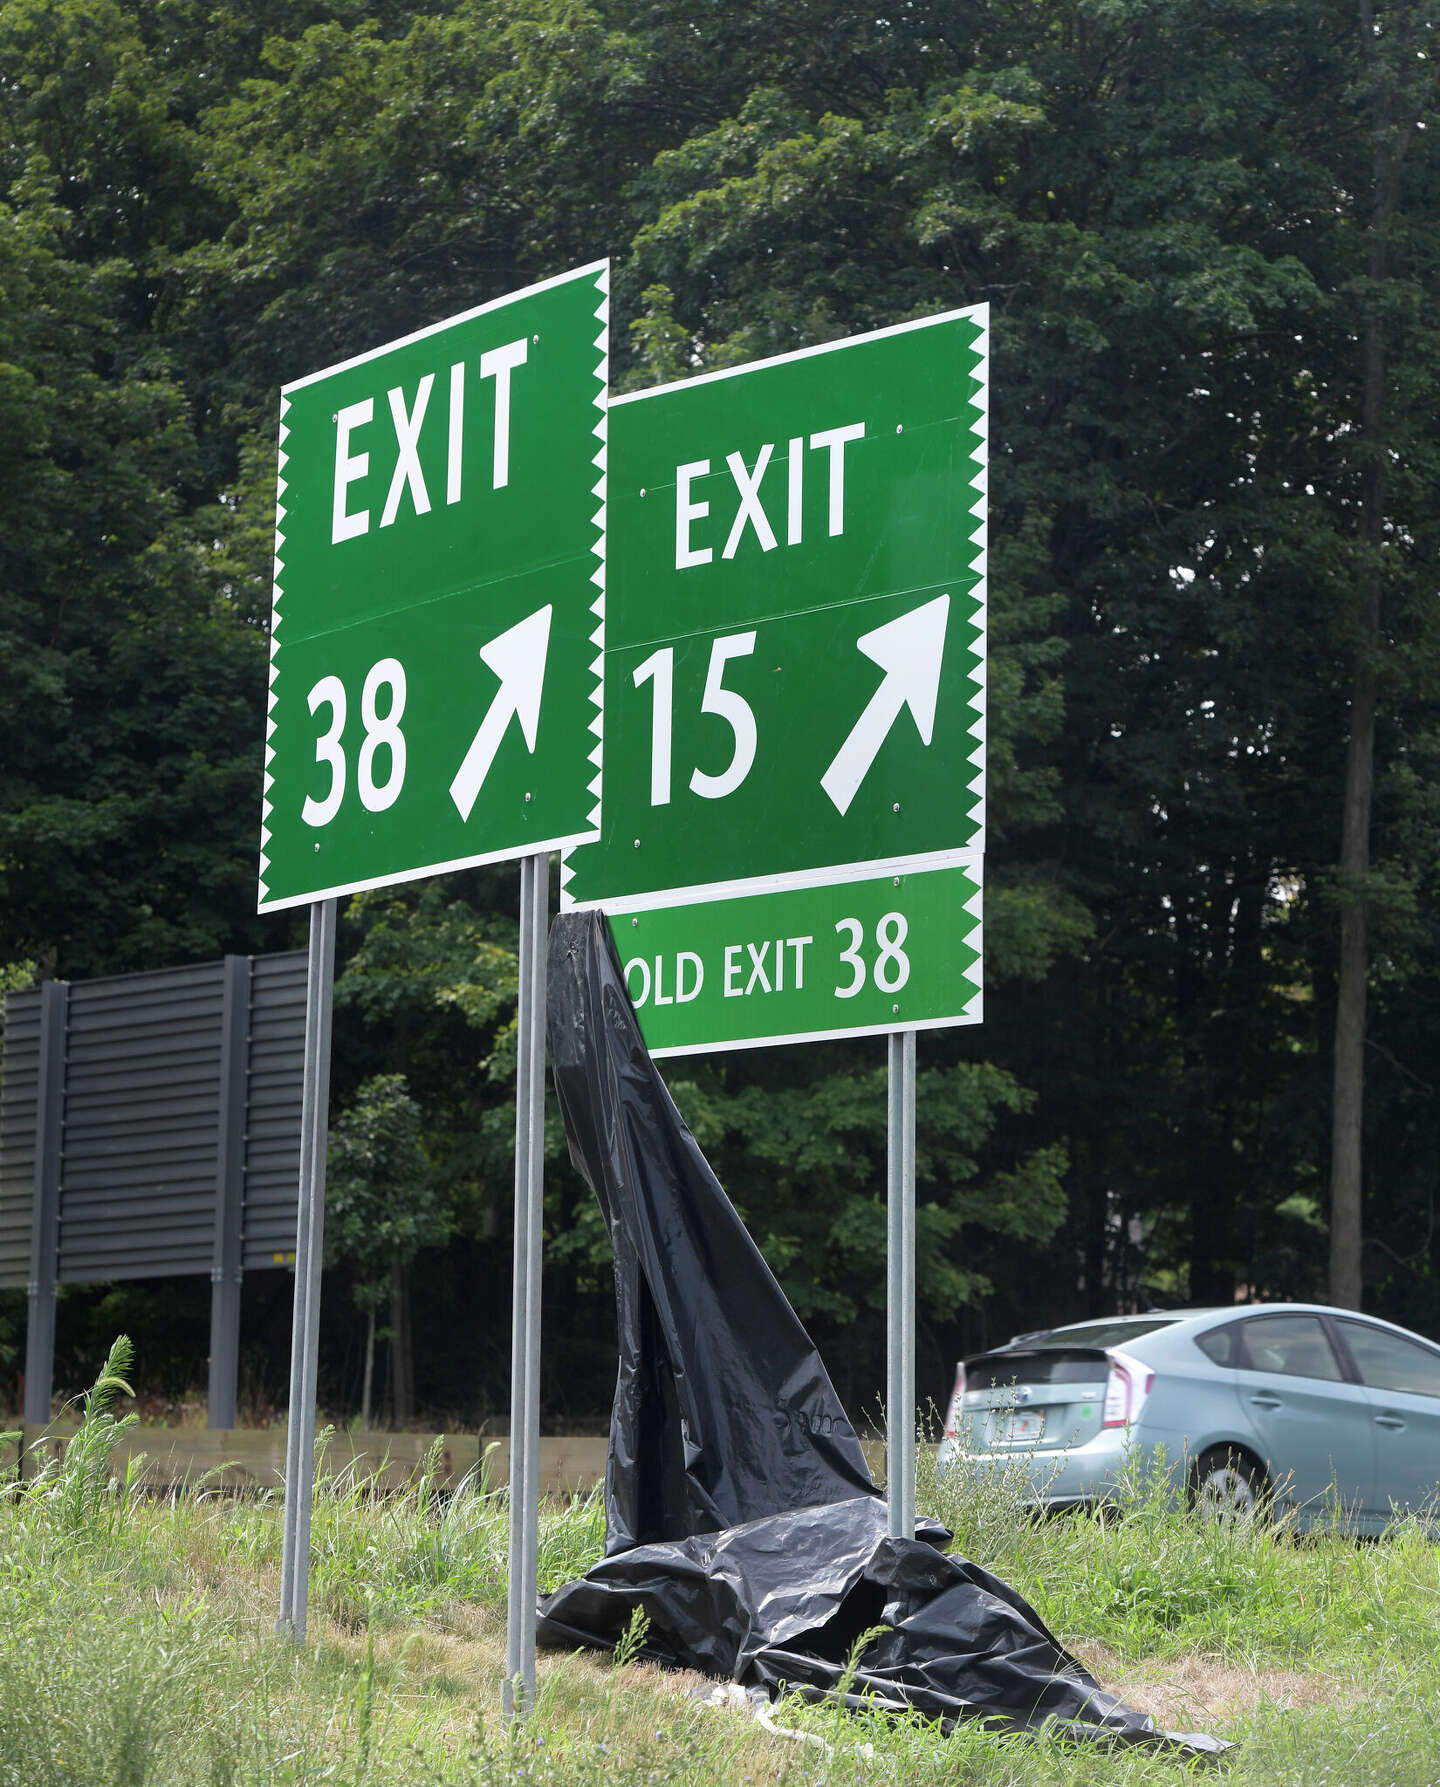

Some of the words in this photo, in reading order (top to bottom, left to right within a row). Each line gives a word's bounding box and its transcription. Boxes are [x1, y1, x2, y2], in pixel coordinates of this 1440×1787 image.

[331, 337, 528, 545] EXIT
[675, 421, 866, 570] EXIT
[301, 657, 407, 827] 38
[632, 630, 758, 807] 15
[623, 951, 704, 1009] OLD
[723, 935, 813, 998] EXIT
[834, 911, 911, 999] 38
